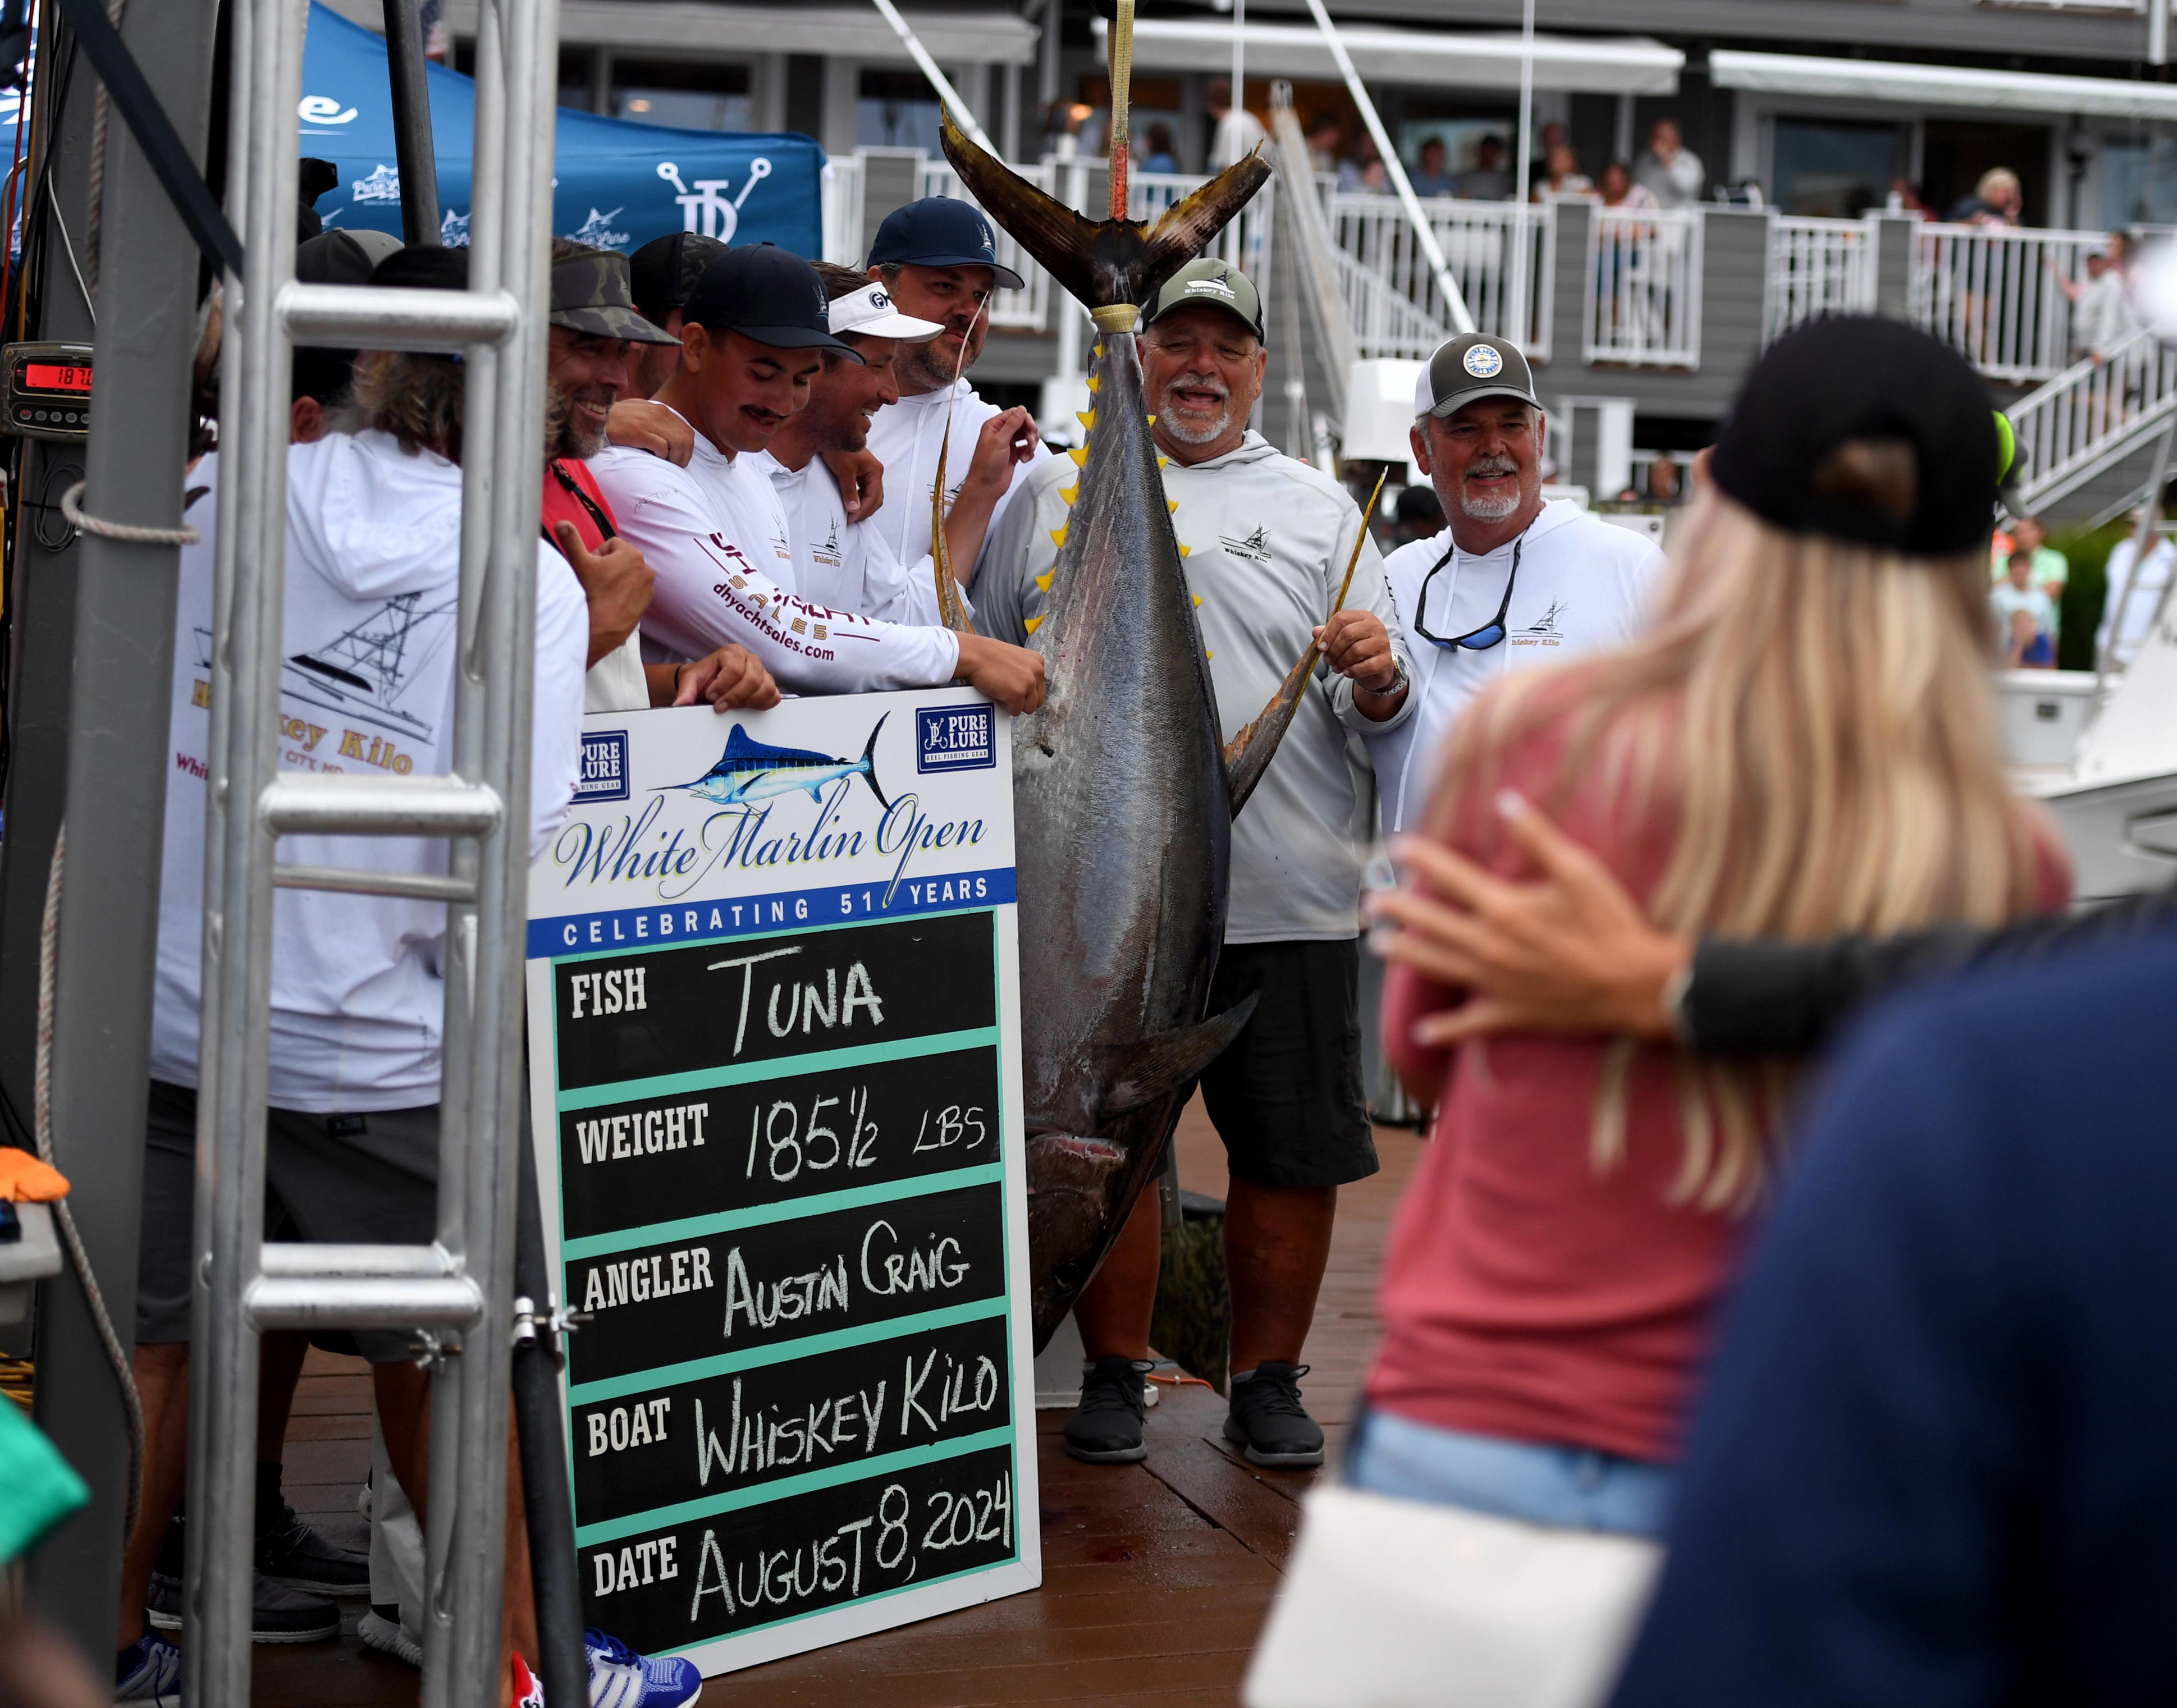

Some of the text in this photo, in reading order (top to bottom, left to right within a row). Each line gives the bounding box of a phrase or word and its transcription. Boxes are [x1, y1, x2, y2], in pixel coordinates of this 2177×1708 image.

[1219, 290, 1235, 299] Kilo
[1224, 547, 1252, 560] Whiskey
[714, 583, 835, 661] dhyachtsales.com
[729, 575, 827, 640] SALES
[338, 729, 413, 775] Kilo
[949, 715, 987, 732] PURE
[949, 730, 988, 749] LURE
[555, 779, 988, 909] White Marlin Open
[563, 877, 988, 947] CELEBRATING 51 YEARS
[571, 967, 647, 1019] FISH
[707, 945, 885, 1057] TUNA
[576, 1103, 708, 1165] WEIGHT
[913, 1105, 985, 1155] LBS
[583, 1247, 714, 1312] ANGLER
[587, 1398, 671, 1457] BOAT
[593, 1536, 678, 1597] DATE
[690, 1470, 1010, 1623] AUGUST 8, 2024
